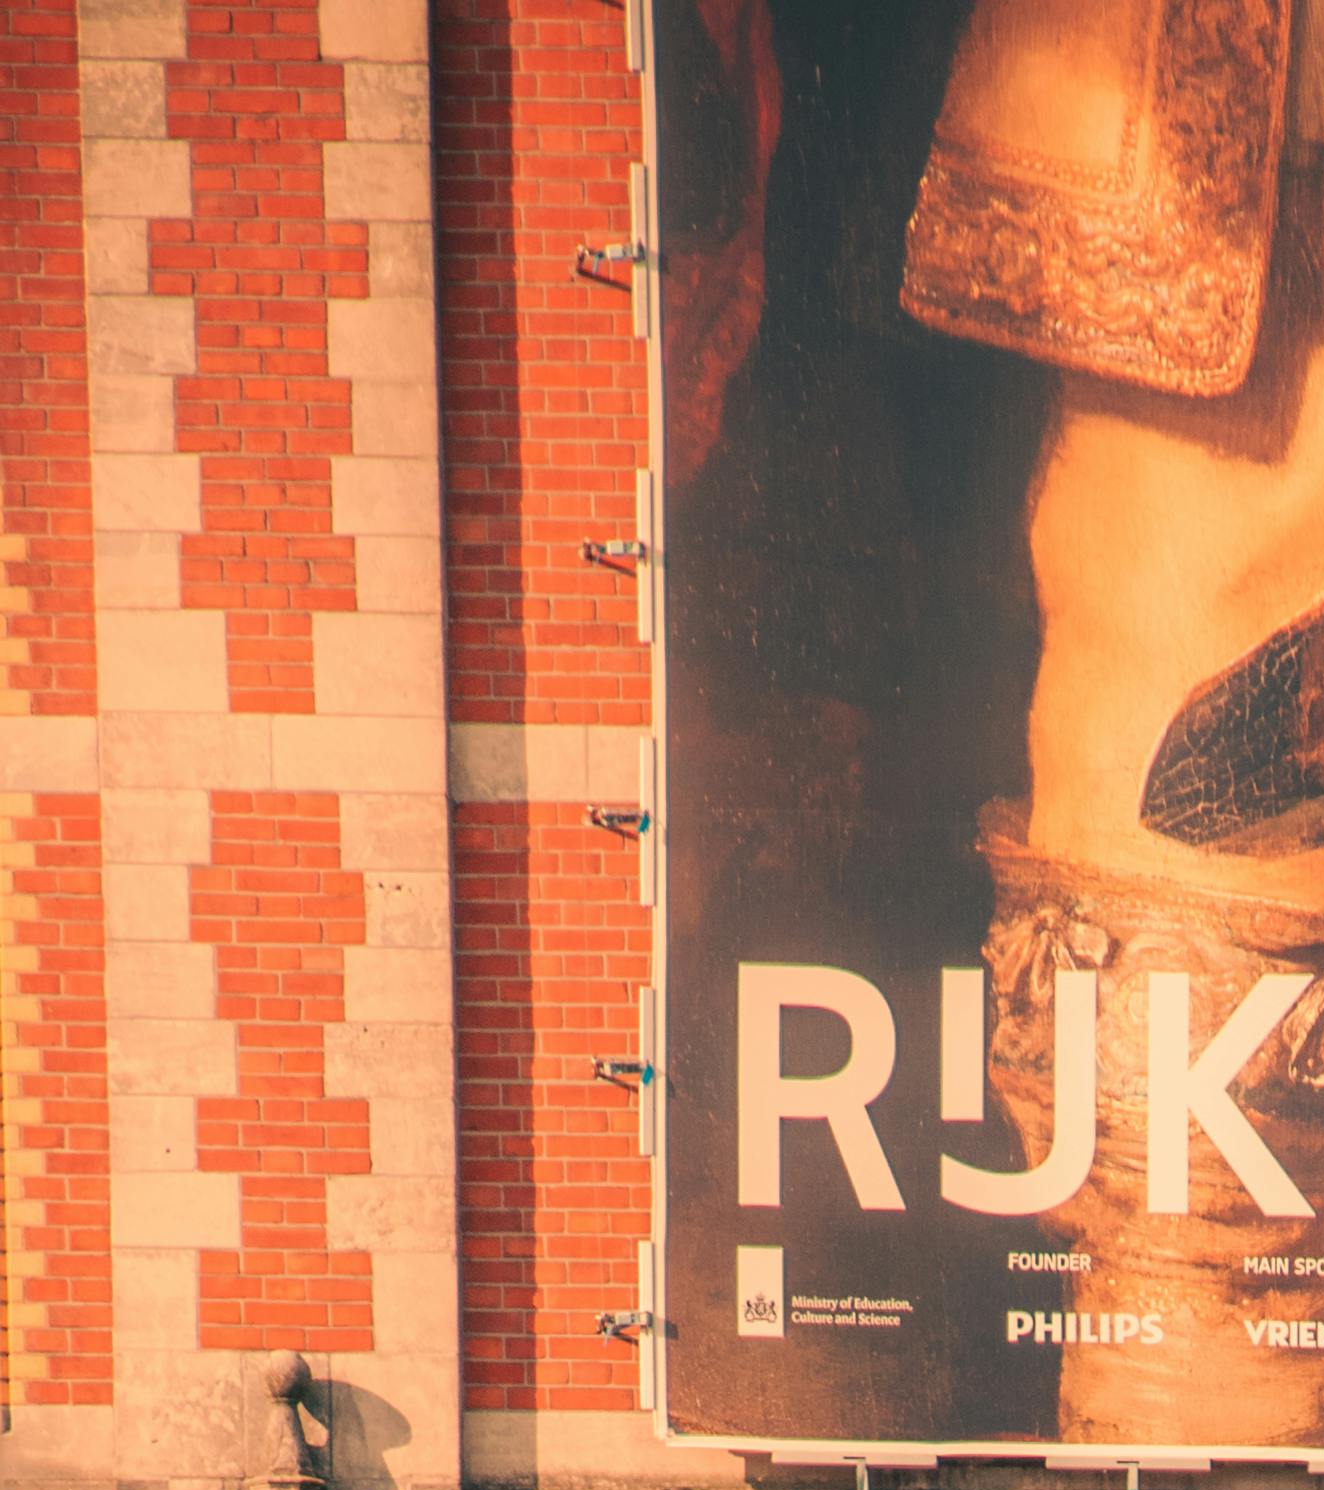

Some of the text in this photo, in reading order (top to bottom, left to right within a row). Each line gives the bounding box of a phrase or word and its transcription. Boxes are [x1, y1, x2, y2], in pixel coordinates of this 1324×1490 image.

[1008, 1253, 1091, 1272] FOUNDER
[1244, 1257, 1288, 1276] MAIN
[791, 1296, 912, 1313] Ministry of Education,
[791, 1311, 900, 1325] Culture and Science
[1007, 1311, 1163, 1346] PHILIPS
